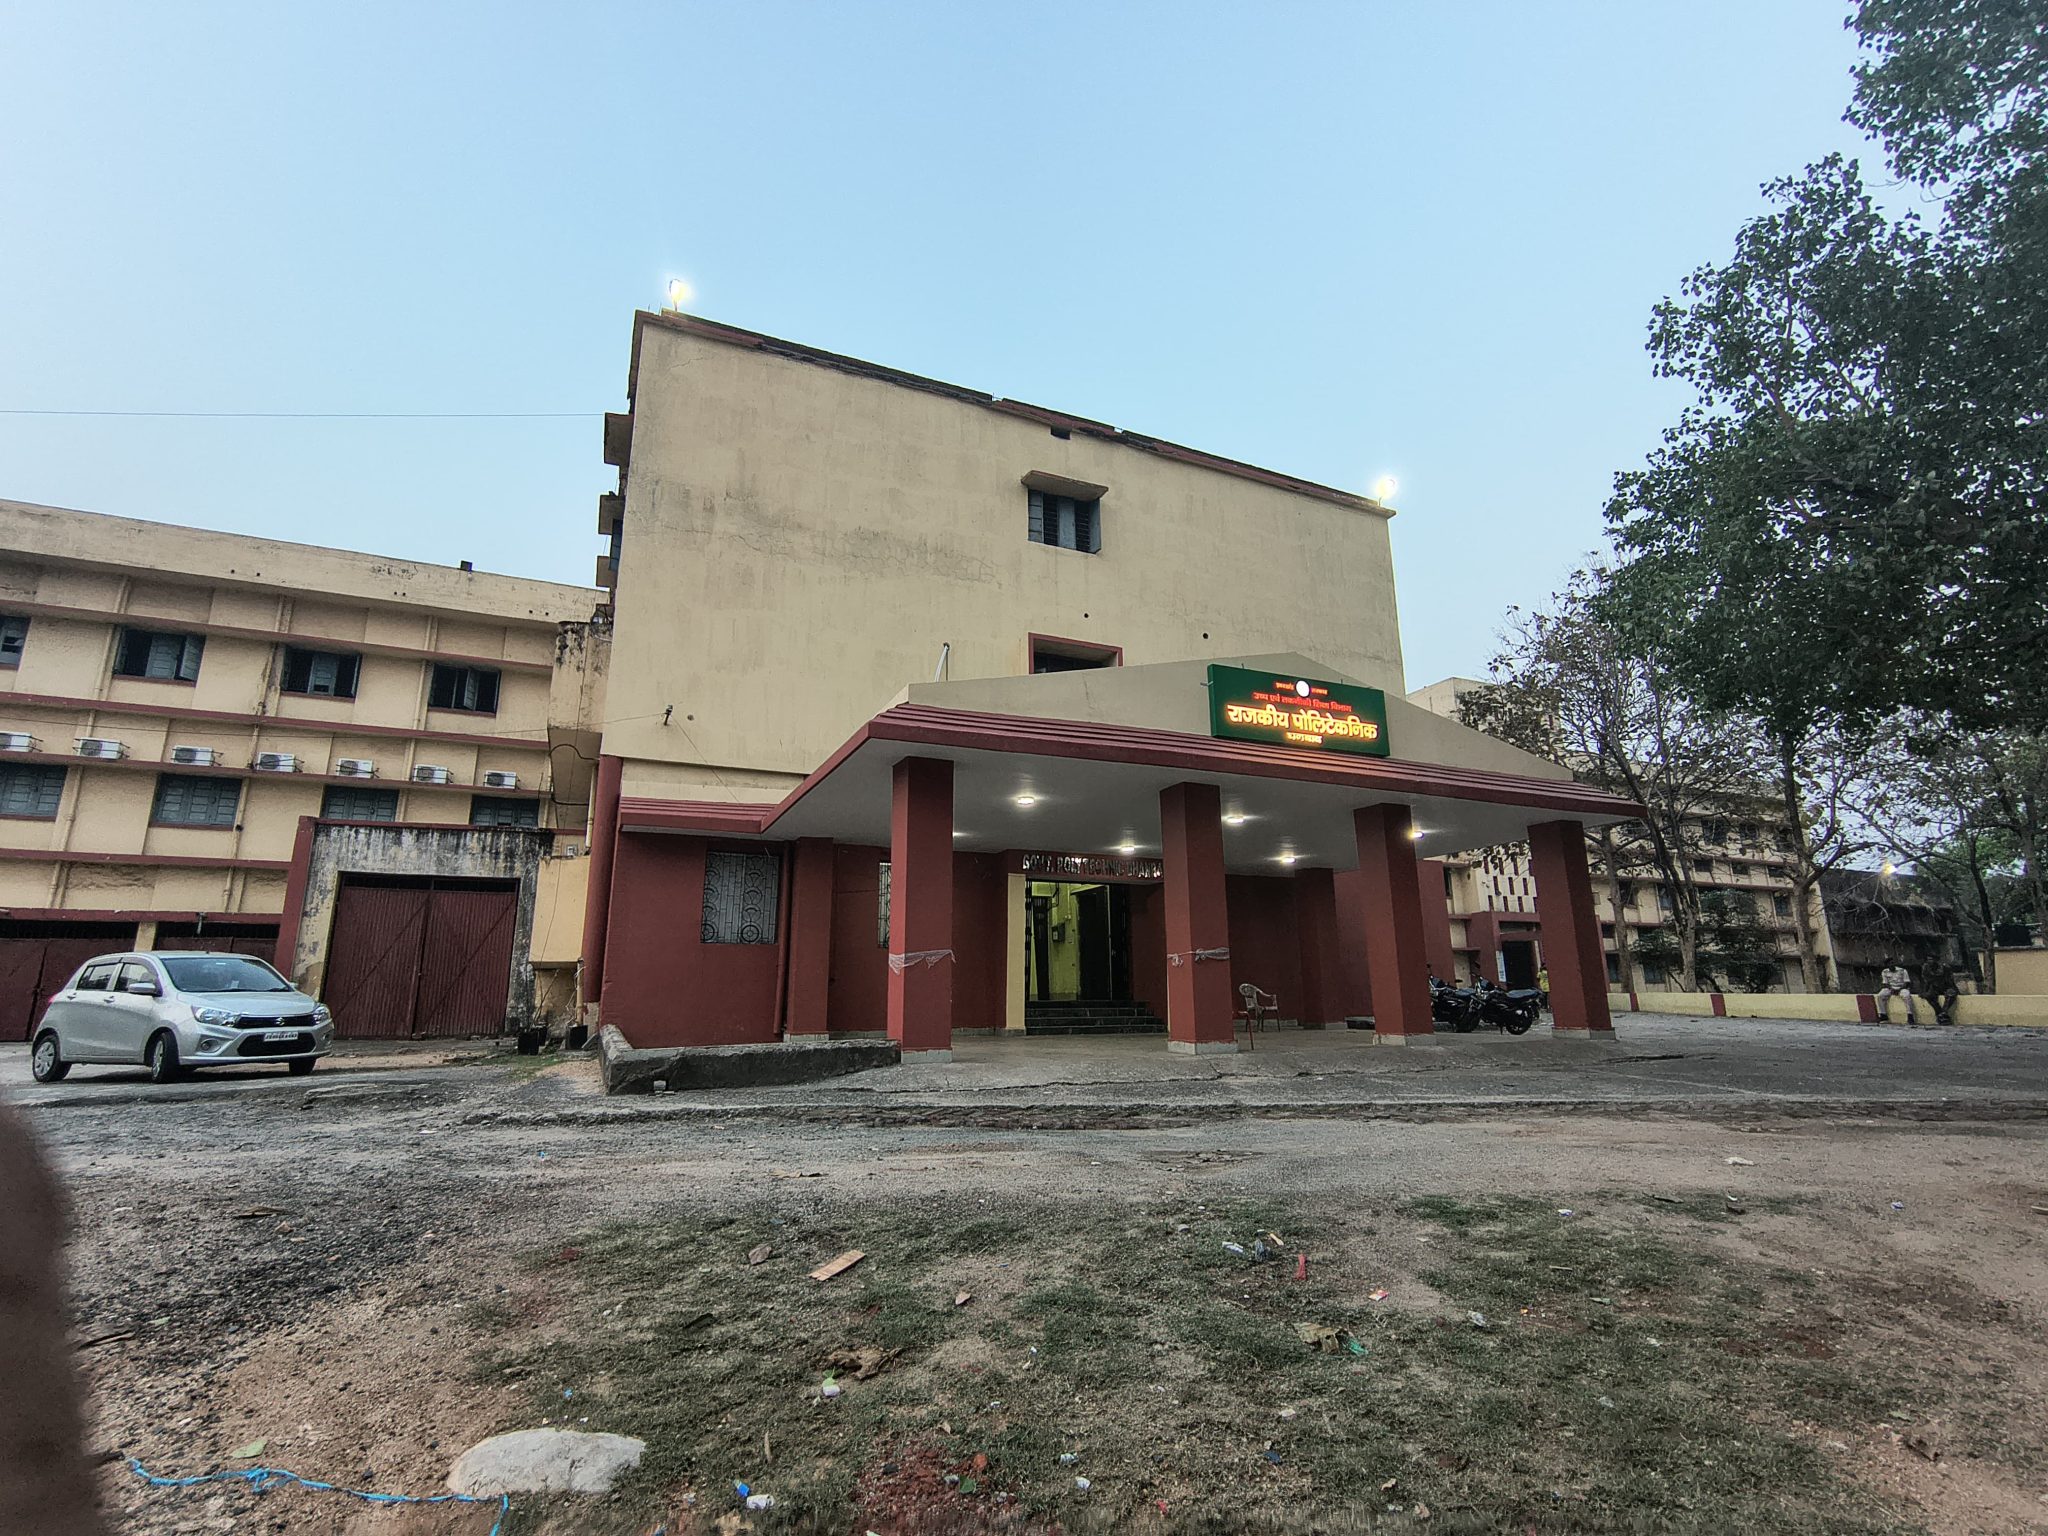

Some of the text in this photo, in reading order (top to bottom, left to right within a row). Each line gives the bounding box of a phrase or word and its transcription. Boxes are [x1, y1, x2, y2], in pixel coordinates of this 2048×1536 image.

[1228, 704, 1377, 739] राजकीय पोलिटेकनिक
[1126, 860, 1164, 878] DHANBA
